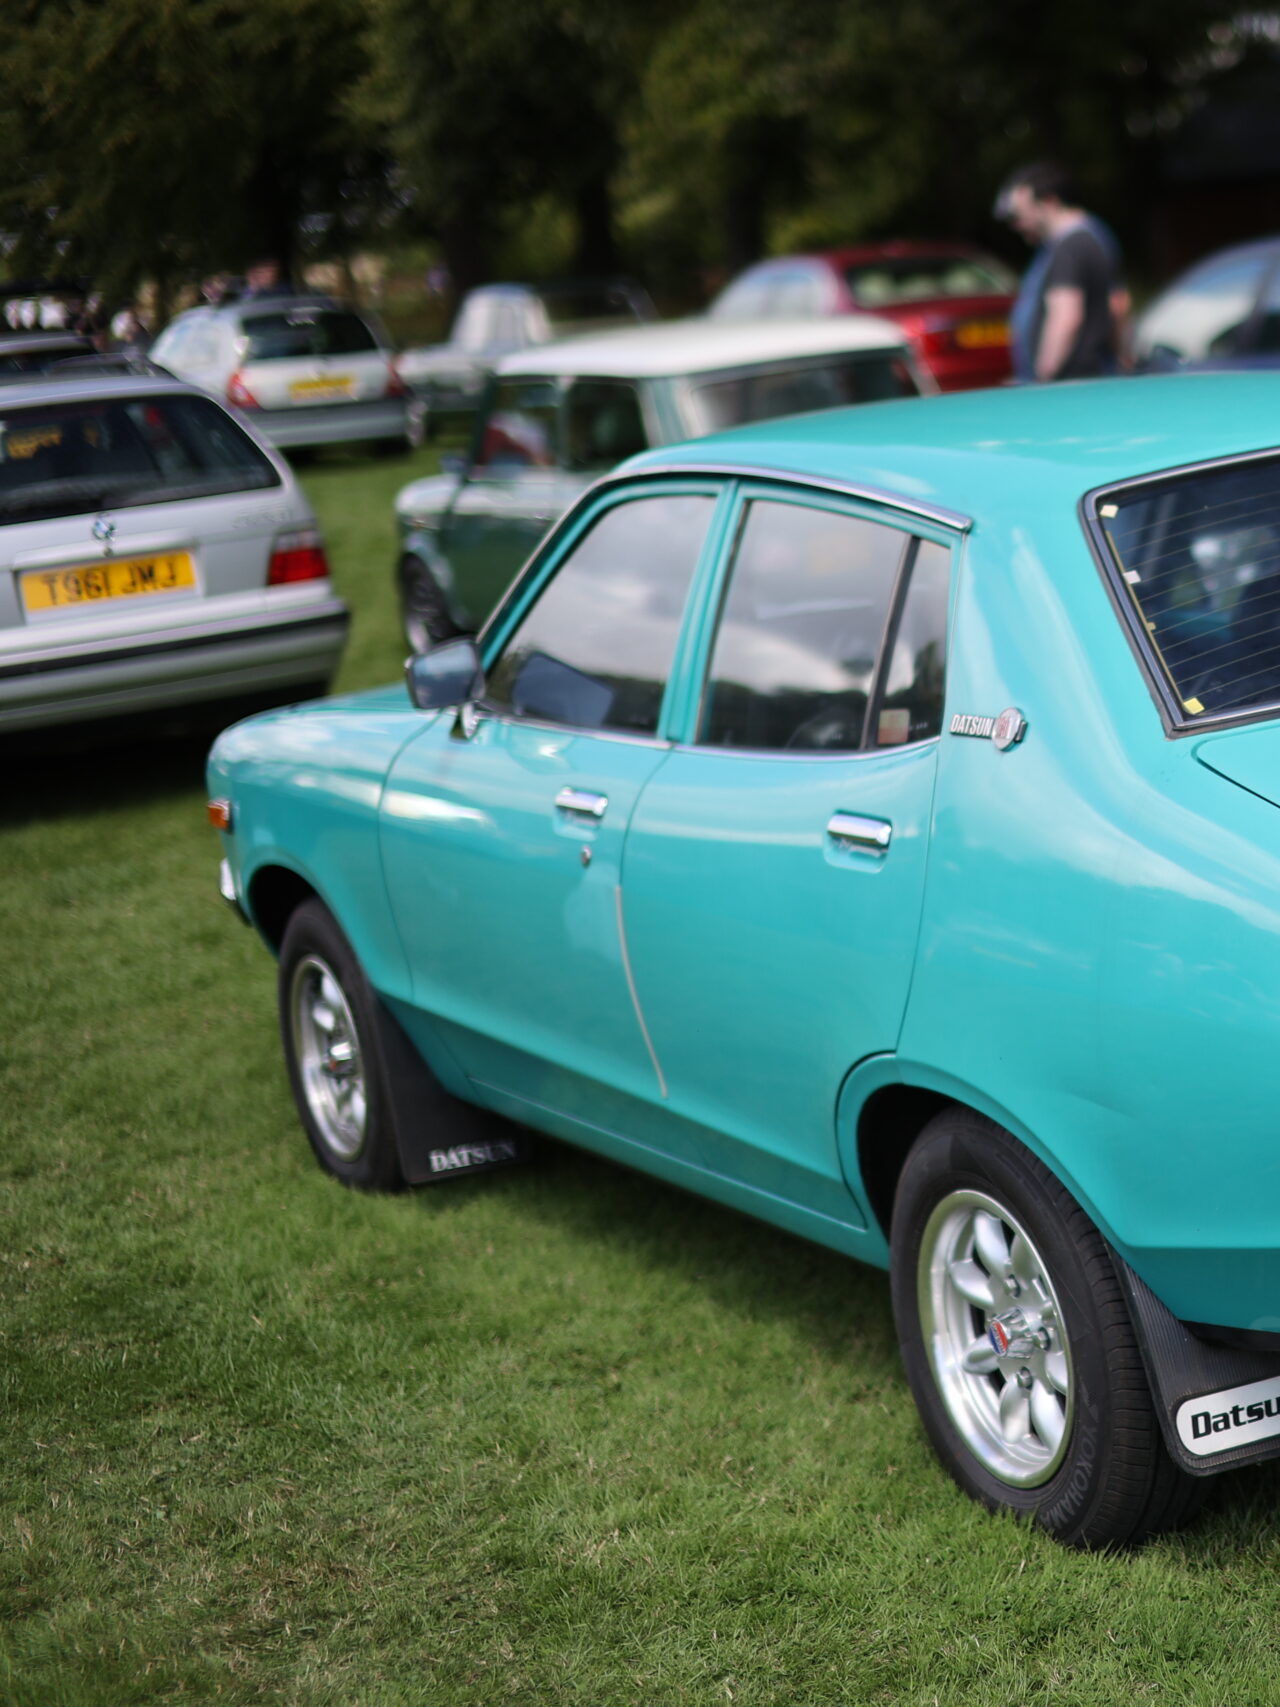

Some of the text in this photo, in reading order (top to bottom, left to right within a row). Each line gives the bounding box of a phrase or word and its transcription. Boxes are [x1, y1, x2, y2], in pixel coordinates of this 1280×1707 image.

[122, 560, 178, 594] JMJ
[950, 713, 994, 737] DATSUN
[1039, 1425, 1098, 1530] YOKOHAMA
